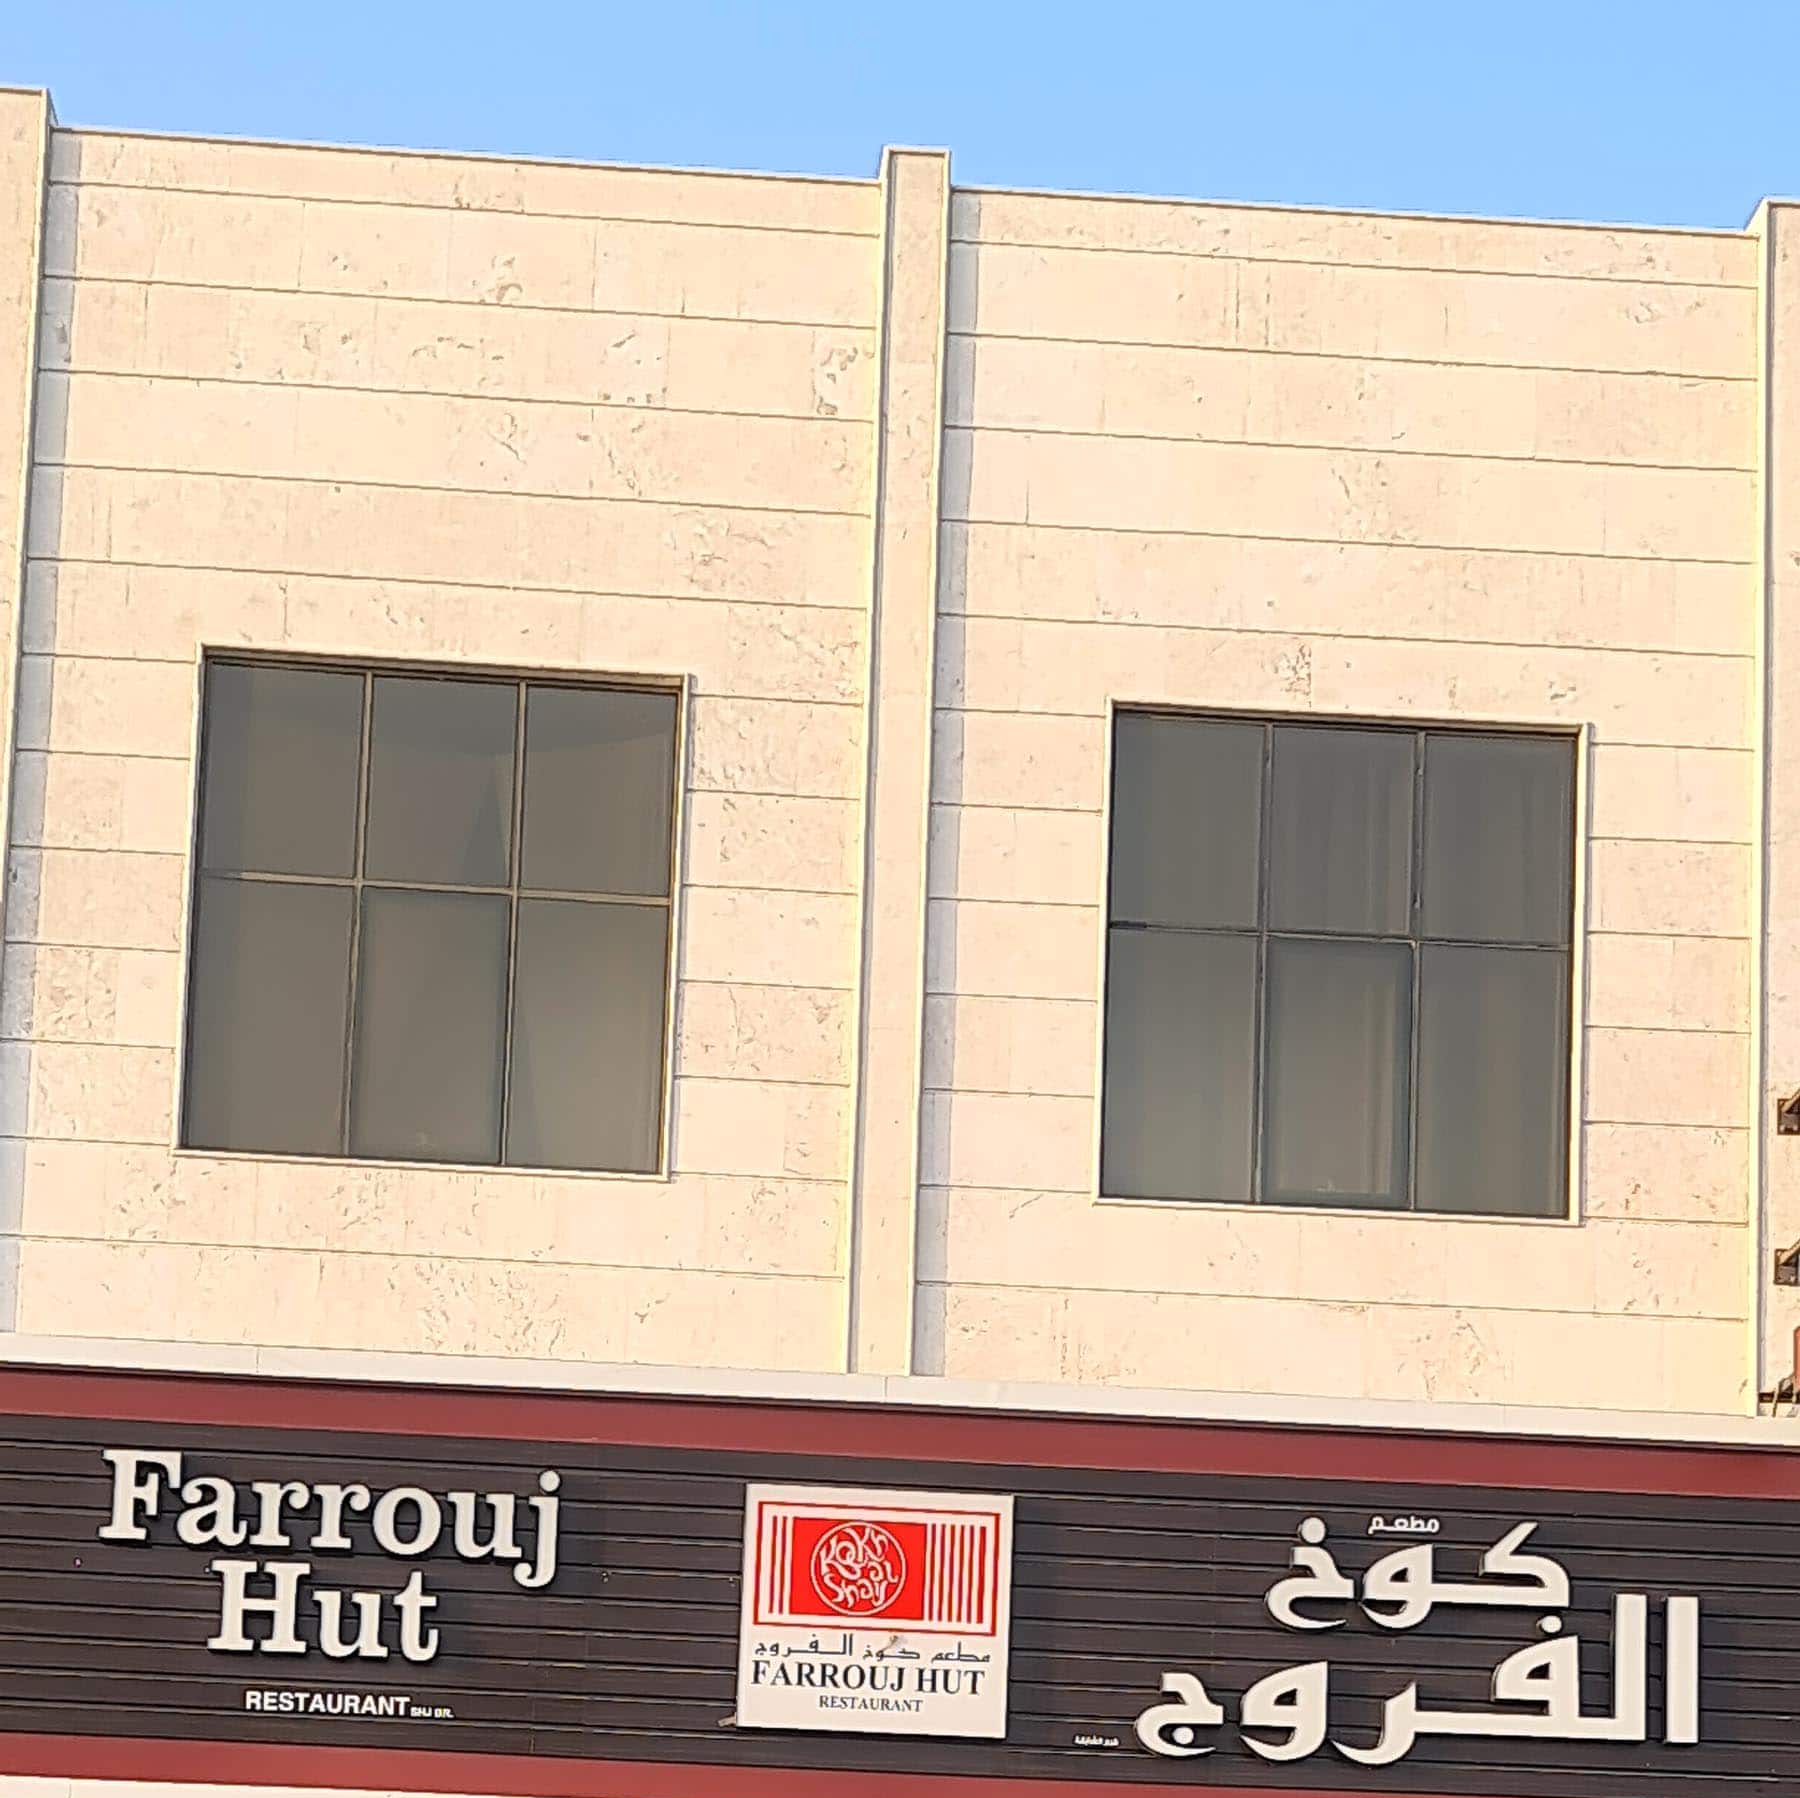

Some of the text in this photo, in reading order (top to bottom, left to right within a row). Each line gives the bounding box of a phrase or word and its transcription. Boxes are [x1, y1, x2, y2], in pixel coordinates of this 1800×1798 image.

[99, 1449, 560, 1588] Farrouj
[1368, 1515, 1440, 1535] مطعم
[1265, 1517, 1570, 1629] كوخ
[206, 1558, 440, 1662] Hut
[754, 1633, 854, 1658] الفروج
[931, 1641, 991, 1663] مطعم
[750, 1660, 985, 1695] FARROUJ HUT
[1133, 1593, 1699, 1765] الفروج
[245, 1690, 411, 1716] RESTAURANT
[818, 1695, 923, 1712] RESTAURANT
